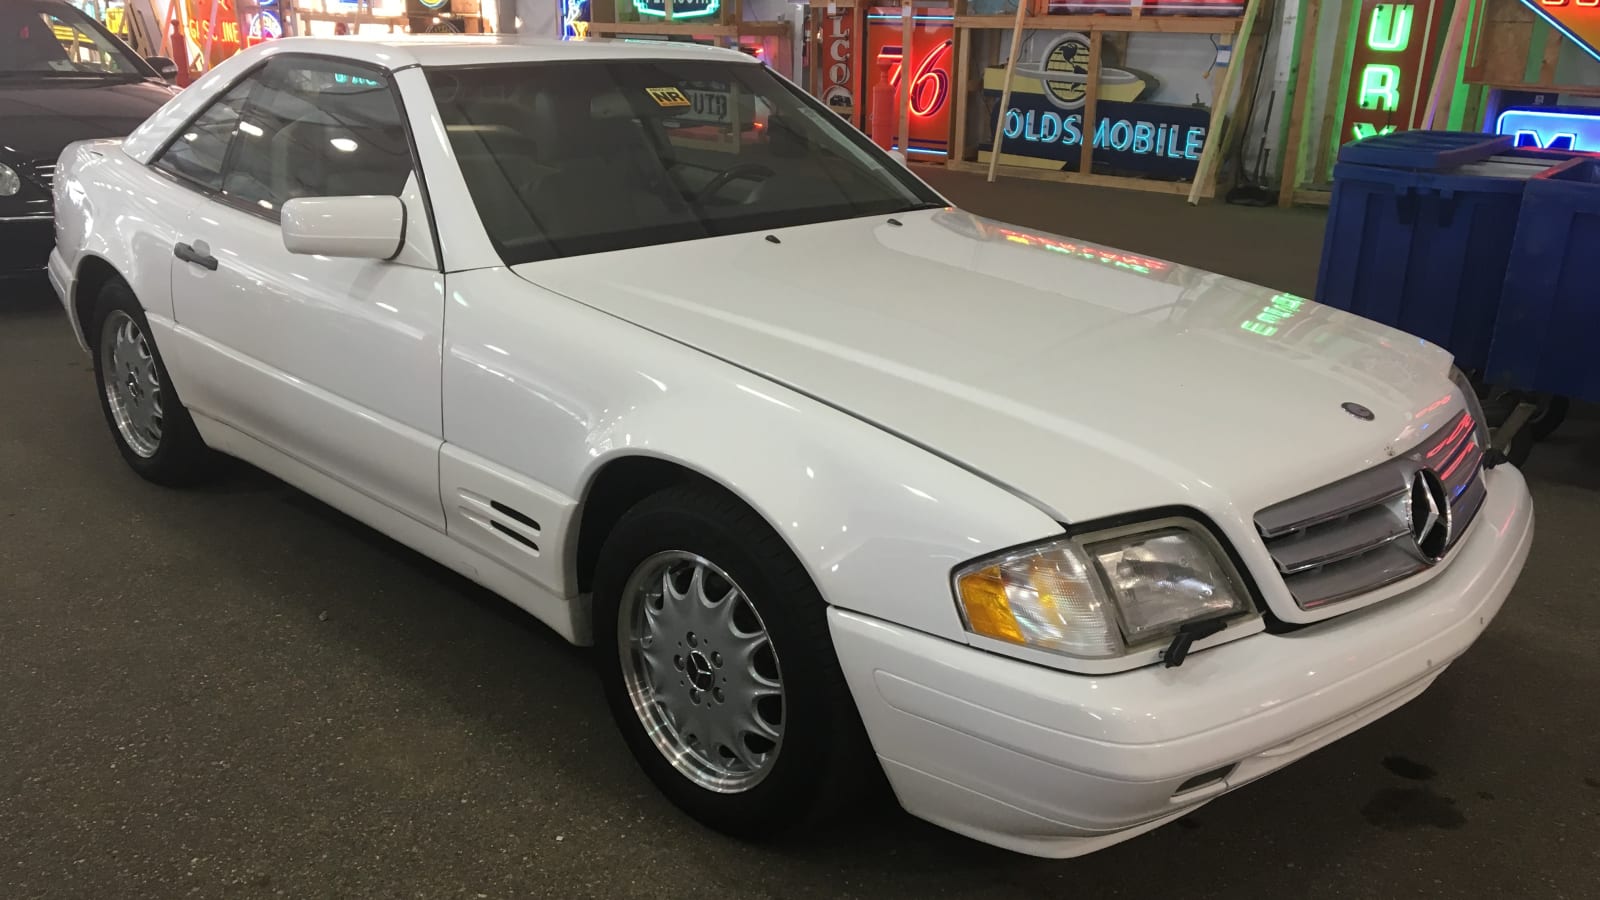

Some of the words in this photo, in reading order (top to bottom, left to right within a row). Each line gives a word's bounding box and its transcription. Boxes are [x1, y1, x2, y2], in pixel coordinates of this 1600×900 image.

[189, 18, 240, 43] GSINE
[651, 91, 686, 103] NR
[1003, 107, 1206, 161] OLDSMOBILE
